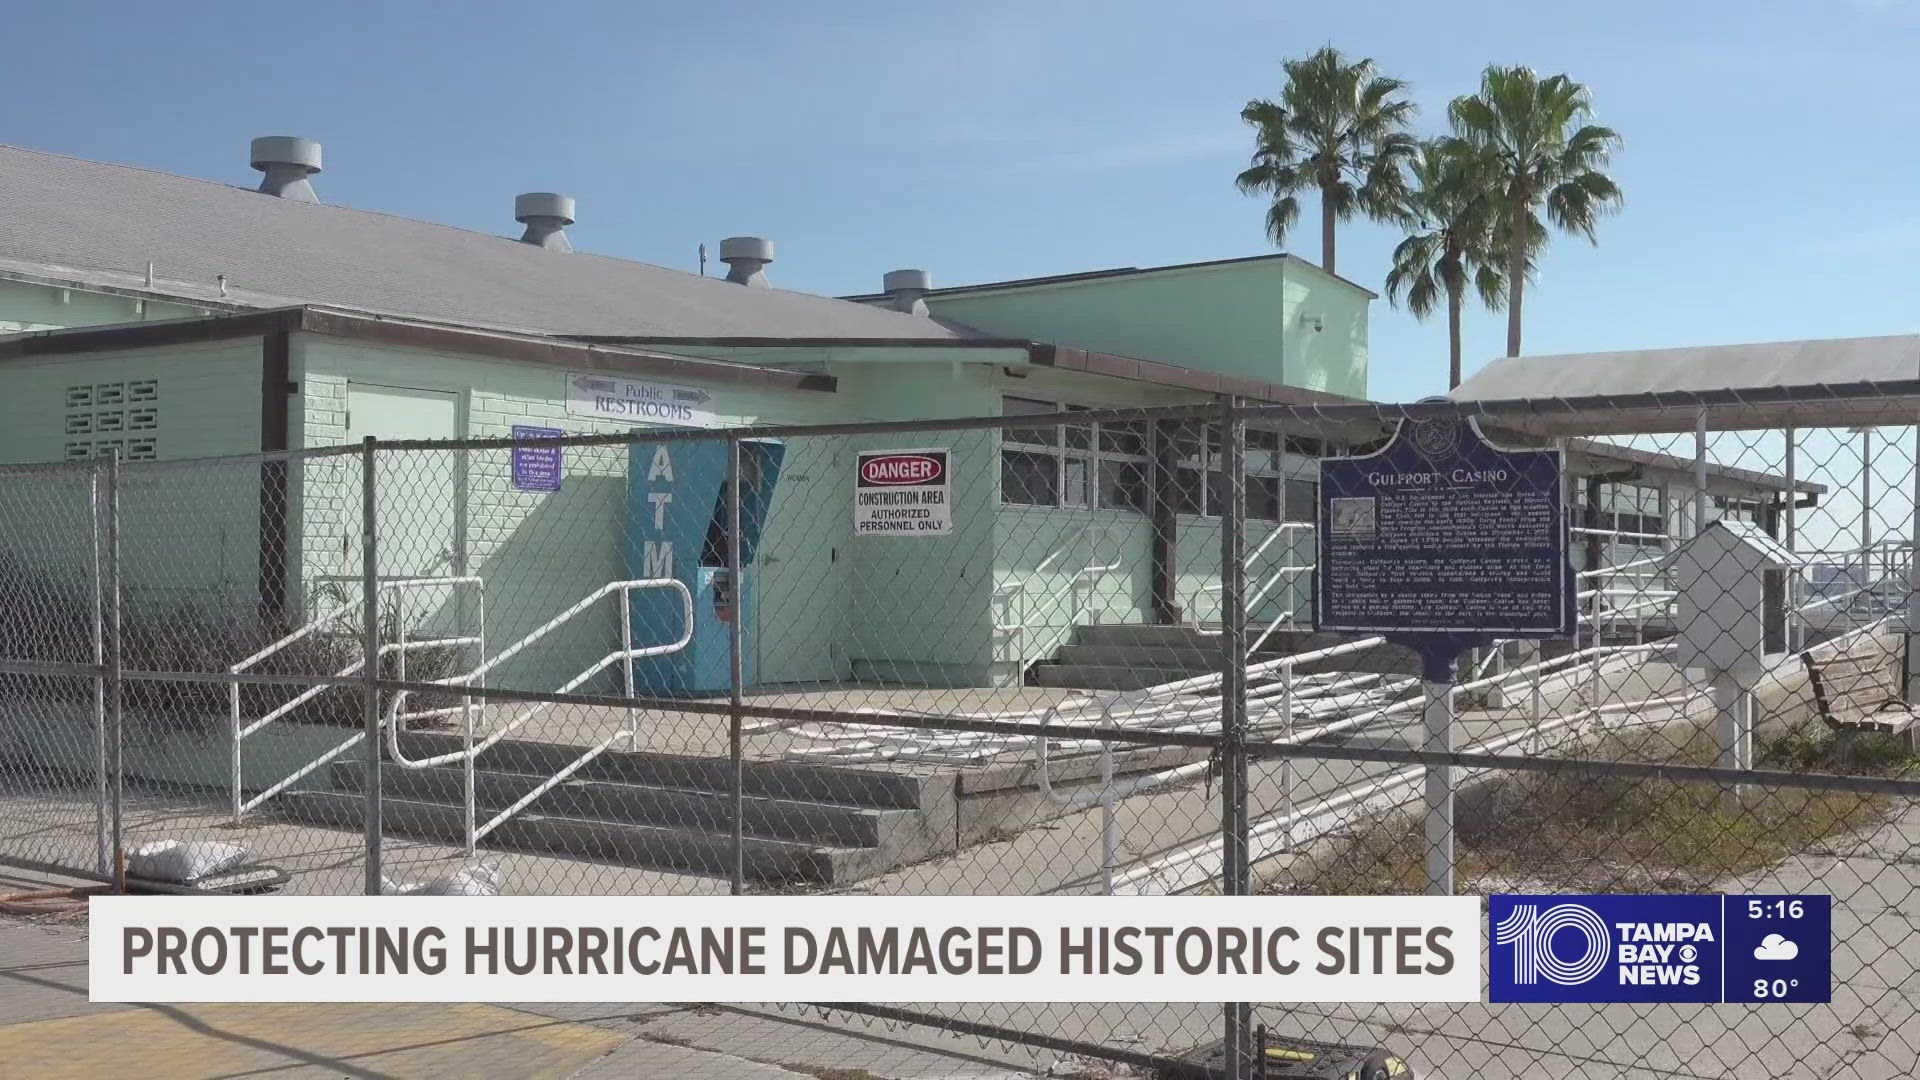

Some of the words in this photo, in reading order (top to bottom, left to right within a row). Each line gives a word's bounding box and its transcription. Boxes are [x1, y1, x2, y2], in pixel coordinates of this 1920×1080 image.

[625, 384, 663, 401] Public
[595, 396, 693, 420] RESTROOMS
[869, 461, 932, 479] DANGER
[1452, 468, 1507, 483] CASINO
[859, 491, 919, 506] CONSTRUCTION
[921, 490, 944, 505] AREA
[643, 444, 675, 578] ATM
[871, 509, 930, 520] AUTHORIZED
[860, 521, 914, 532] PERSONNEL
[918, 520, 943, 531] ONLY
